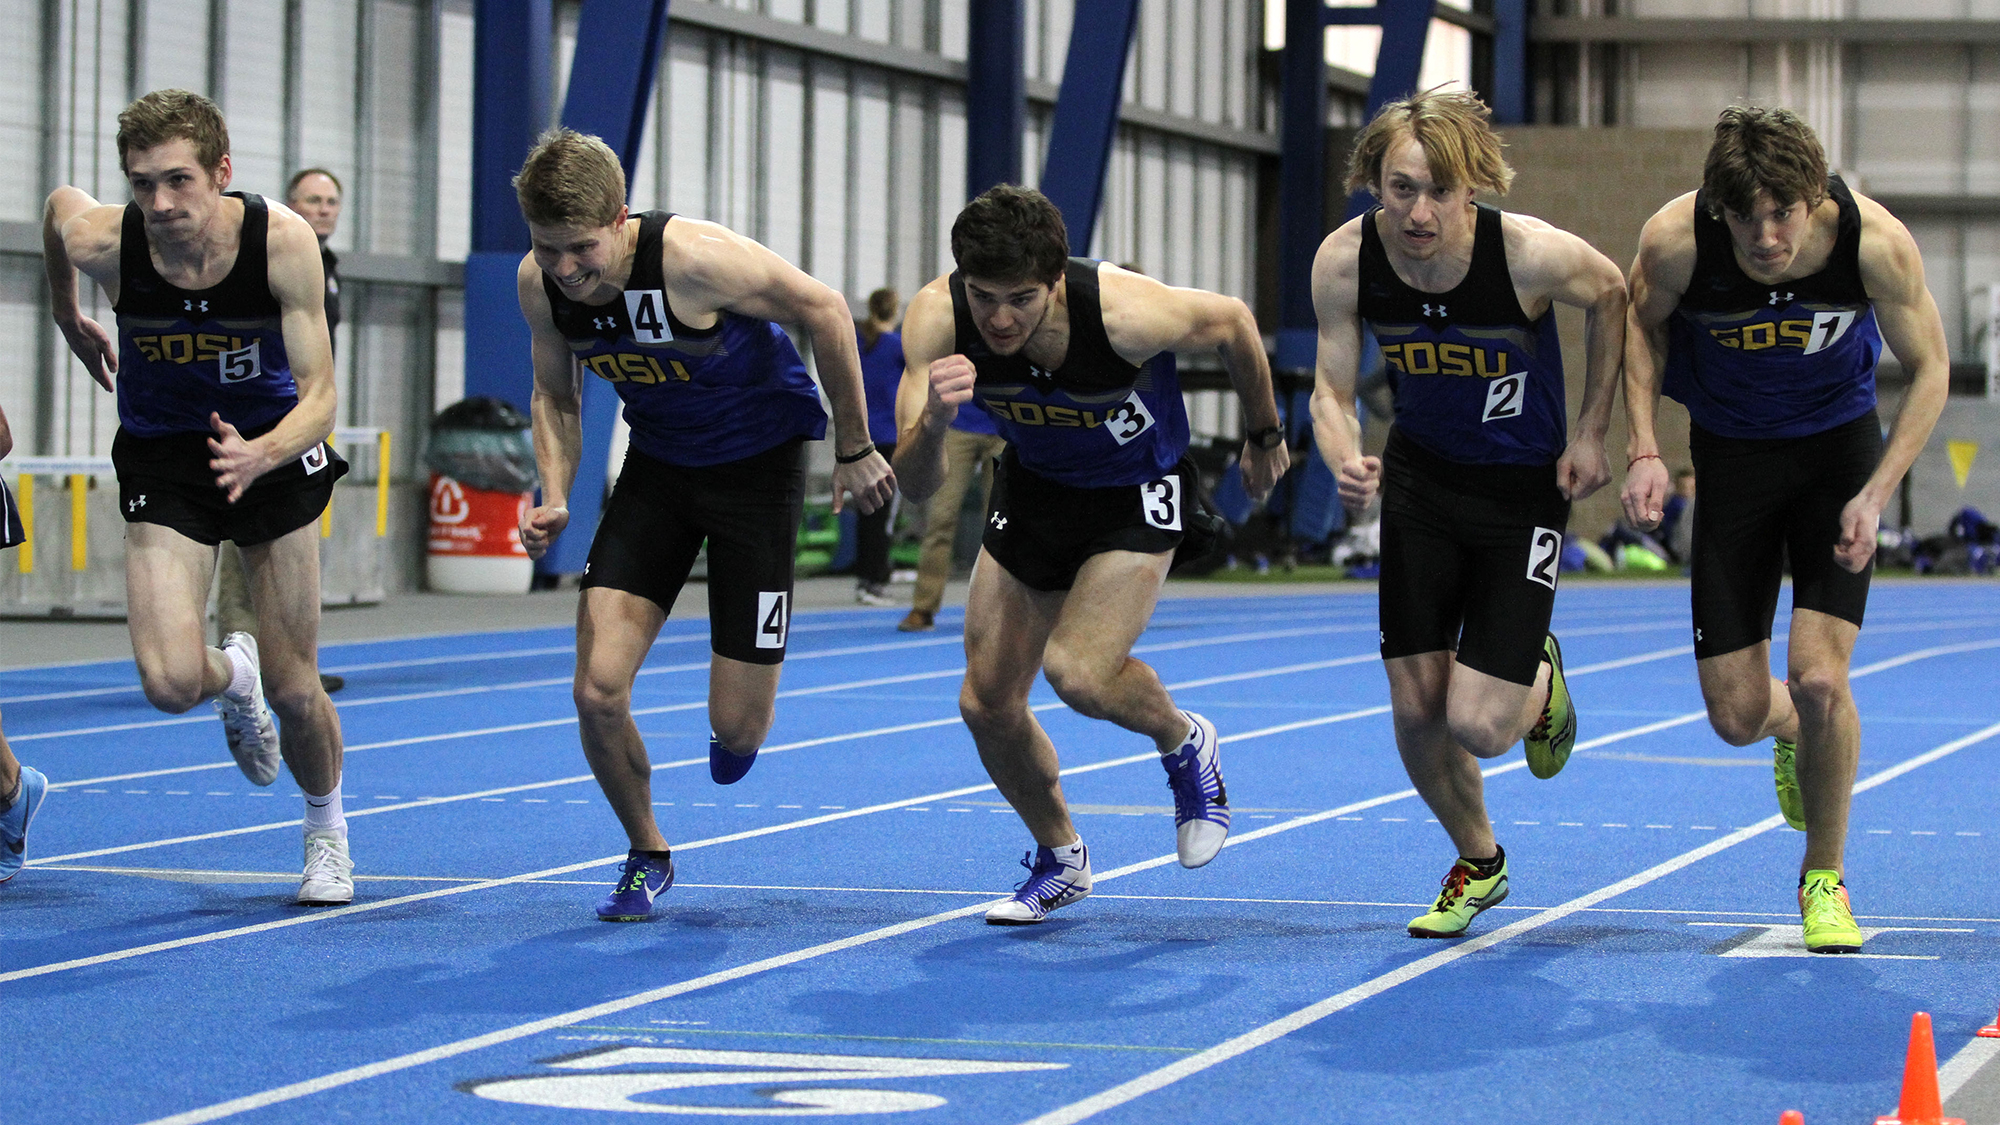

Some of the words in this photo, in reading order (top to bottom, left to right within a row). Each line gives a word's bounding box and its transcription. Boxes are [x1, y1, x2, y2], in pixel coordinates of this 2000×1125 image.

[635, 293, 665, 340] 4
[1709, 320, 1814, 351] SDS
[1818, 315, 1841, 350] 1
[224, 350, 254, 380] 5
[1487, 377, 1519, 419] 2
[1110, 401, 1146, 439] 3
[1146, 478, 1175, 526] 3
[1531, 532, 1558, 585] 2
[762, 595, 784, 644] 4
